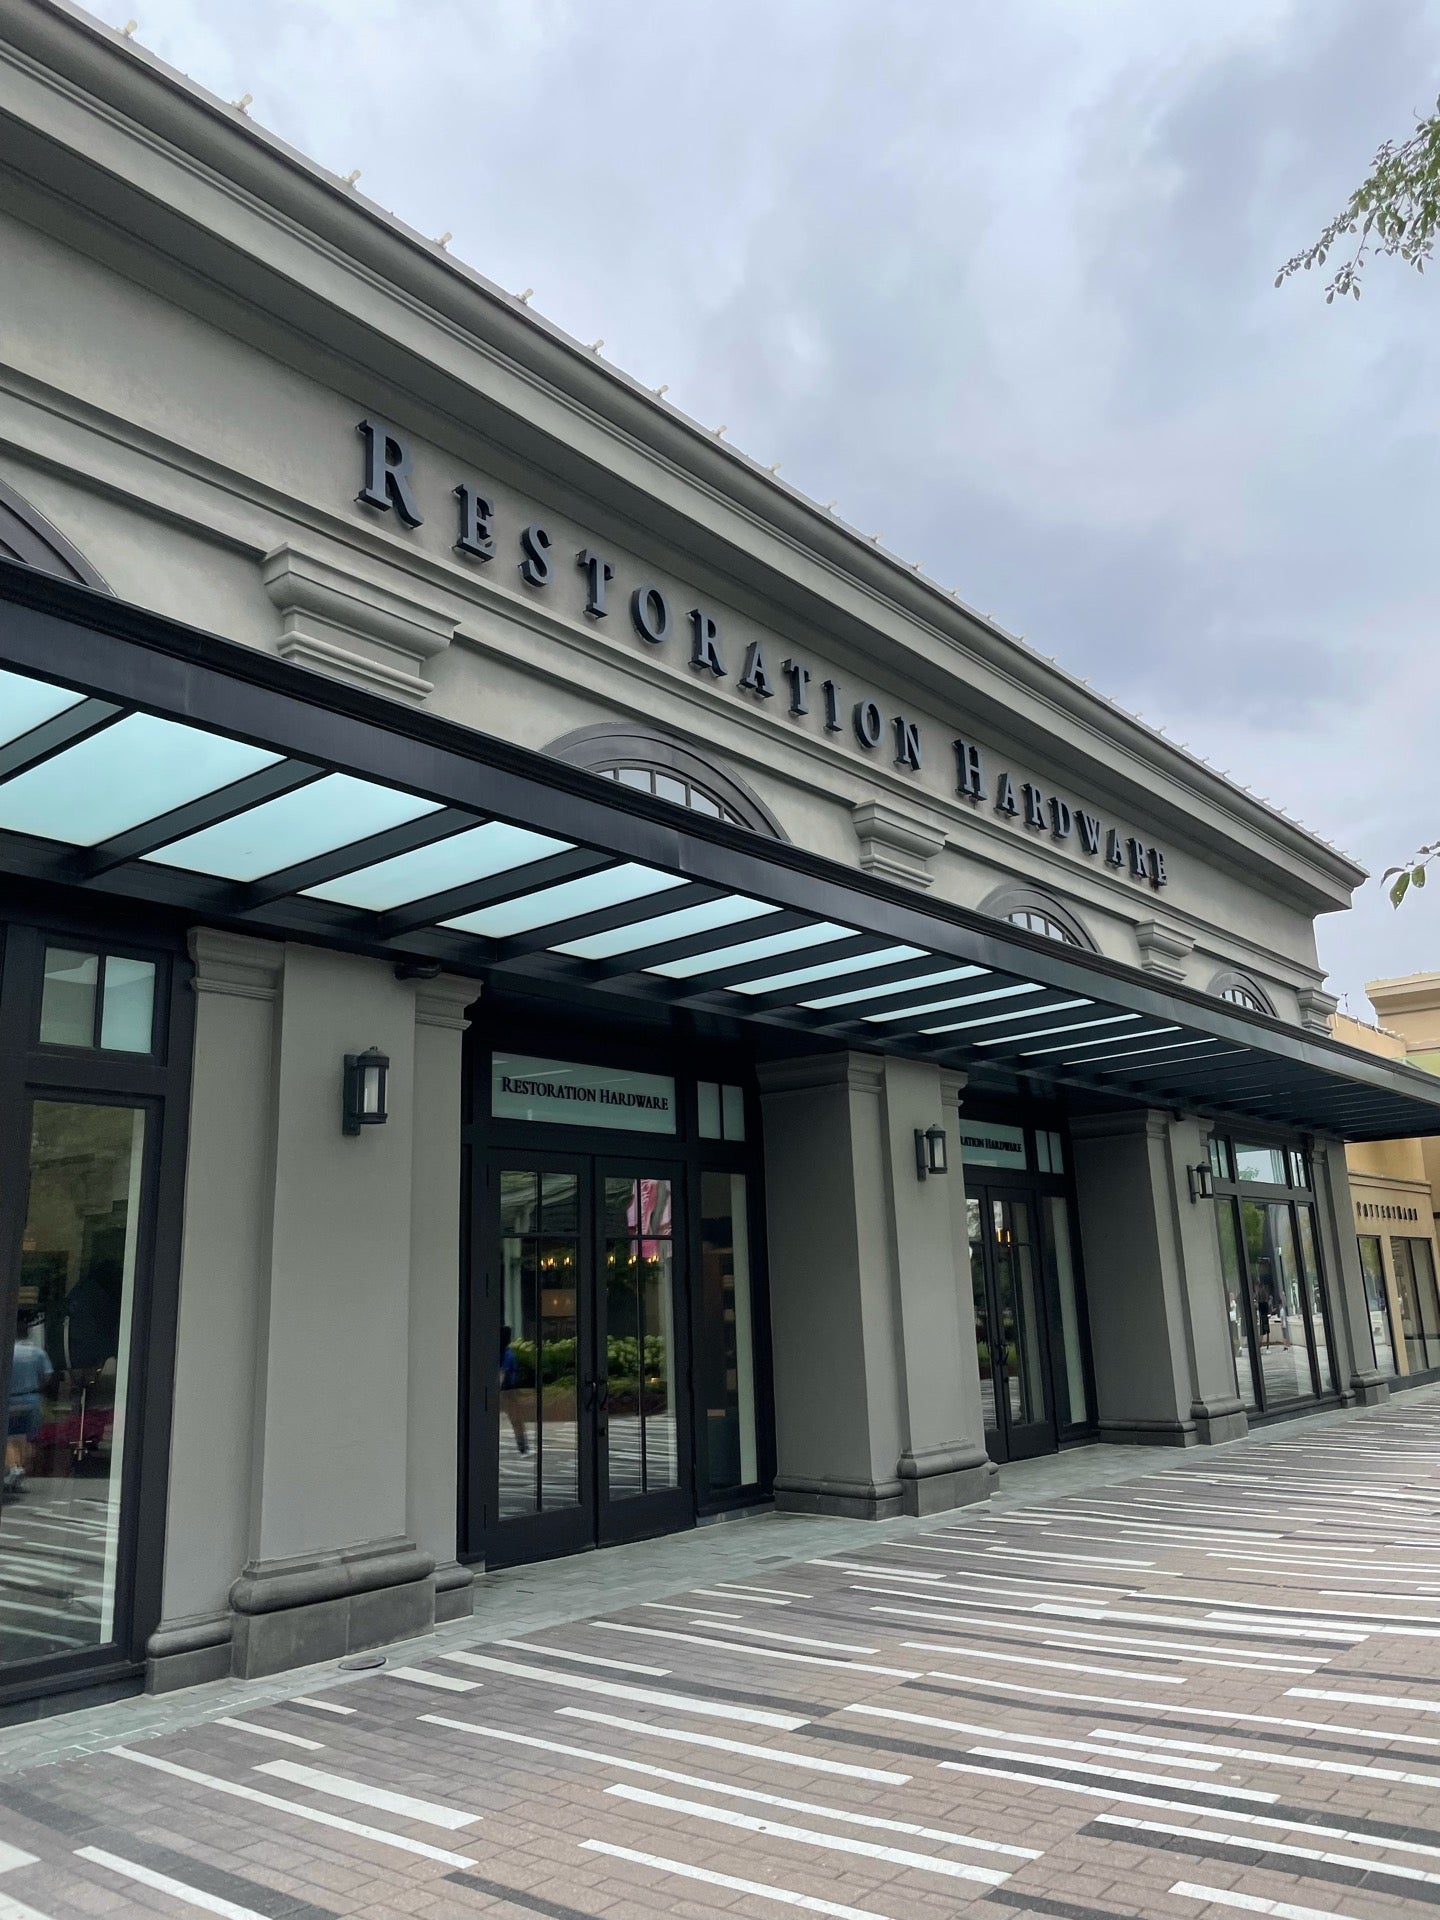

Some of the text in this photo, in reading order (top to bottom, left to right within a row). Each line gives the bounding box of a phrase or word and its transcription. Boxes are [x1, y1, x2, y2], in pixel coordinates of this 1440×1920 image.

[354, 418, 1168, 888] RESTORATION HARDWARE
[502, 1076, 669, 1111] RESTORATION HARDWARE
